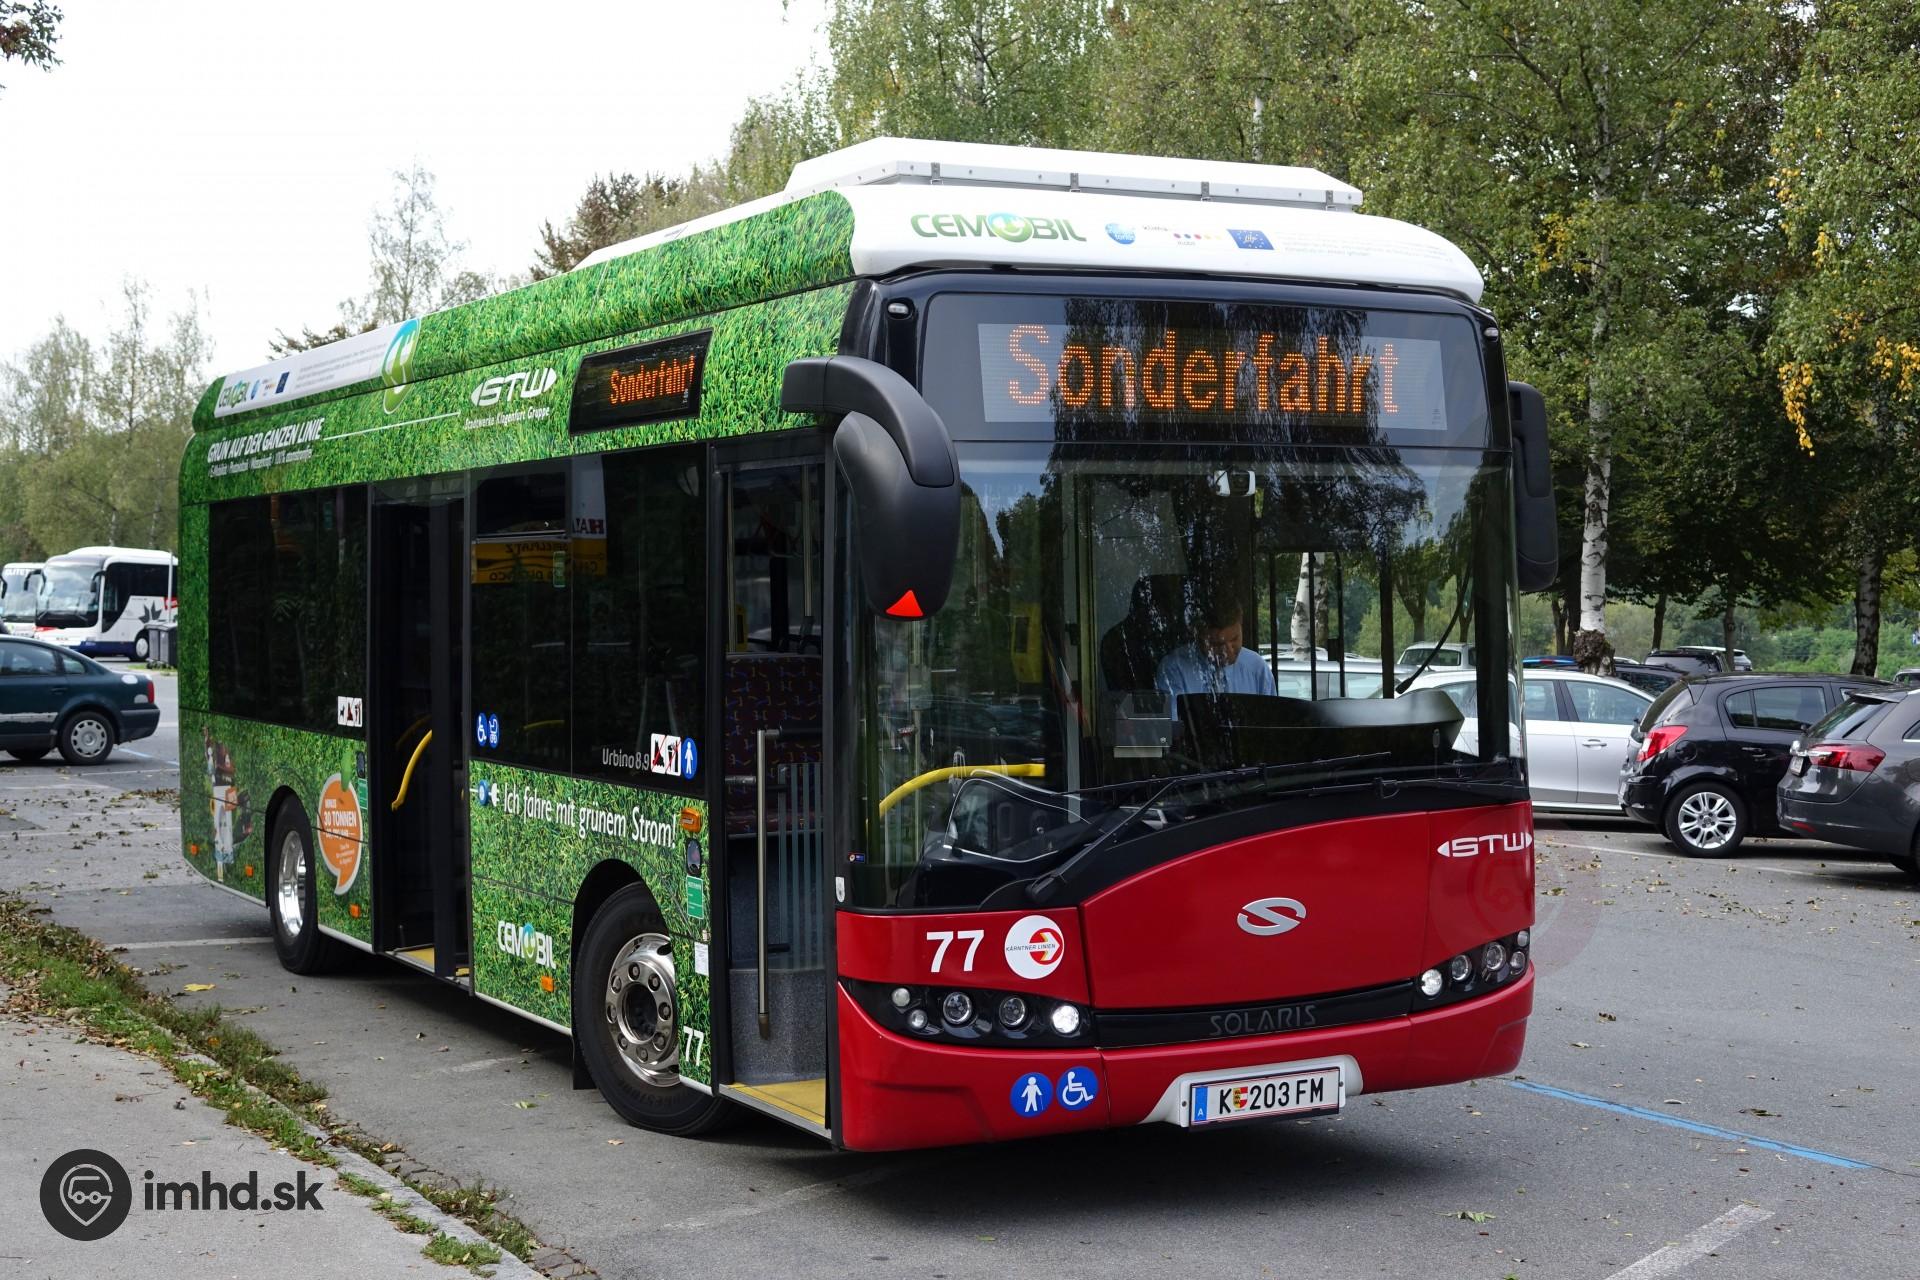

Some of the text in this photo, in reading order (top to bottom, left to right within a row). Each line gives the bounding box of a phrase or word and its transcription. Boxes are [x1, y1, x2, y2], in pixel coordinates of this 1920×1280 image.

[910, 212, 1087, 243] CEMOBIL
[475, 367, 554, 407] STW
[610, 354, 696, 405] Sonderfahrt
[1008, 323, 1399, 414] Sonderfahrt
[528, 406, 550, 421] Gruppe
[207, 437, 231, 463] GRÜN
[228, 436, 247, 459] AUF
[244, 432, 264, 455] DER
[262, 424, 300, 451] GANZEN
[297, 417, 325, 444] LINIE
[602, 747, 635, 769] Urbino
[324, 810, 357, 827] 30 TONNEN
[503, 783, 677, 849] Ich fahre mit grünem Strom!
[1446, 832, 1529, 857] STW
[498, 920, 557, 969] CEMOBIL
[926, 929, 985, 973] 77
[1209, 1004, 1317, 1037] SOLARIS
[683, 1026, 704, 1066] 77
[1197, 1107, 1204, 1117] A
[1219, 1077, 1324, 1114] K 203 FM
